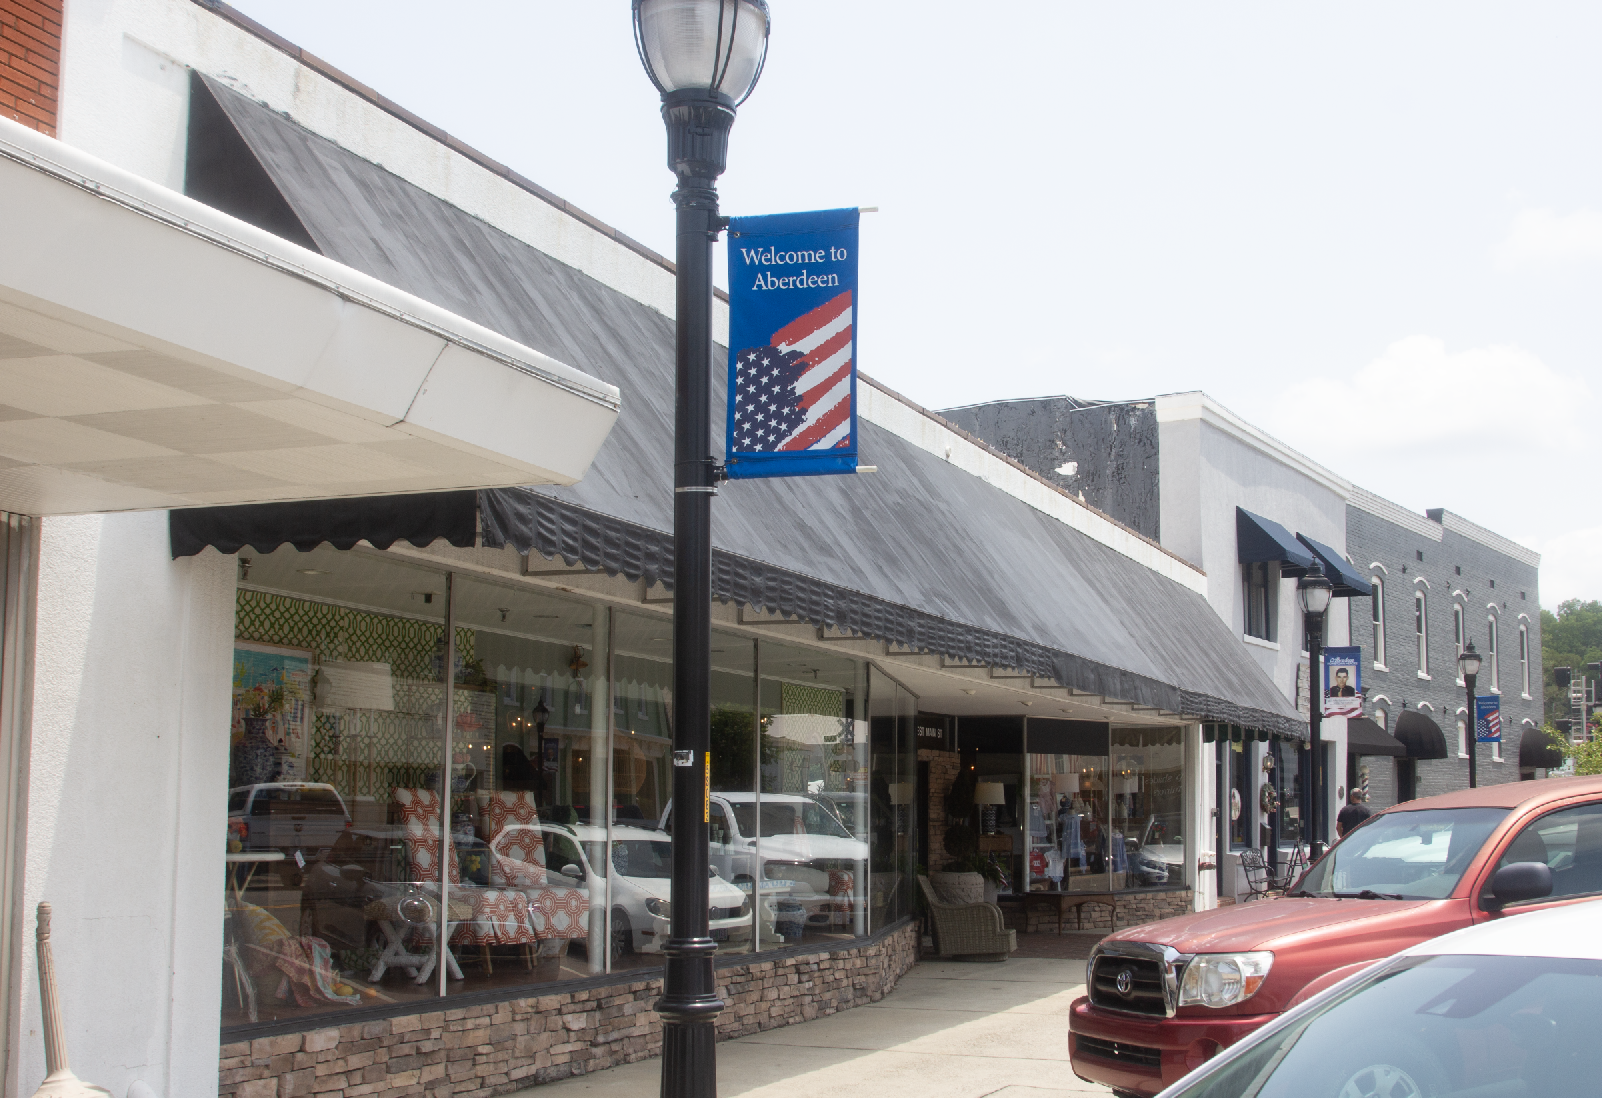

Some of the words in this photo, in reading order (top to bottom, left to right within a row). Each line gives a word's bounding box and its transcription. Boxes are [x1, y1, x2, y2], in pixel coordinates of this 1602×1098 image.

[740, 246, 825, 266] Welcome
[829, 245, 848, 262] to
[751, 269, 839, 291] Aberdeen
